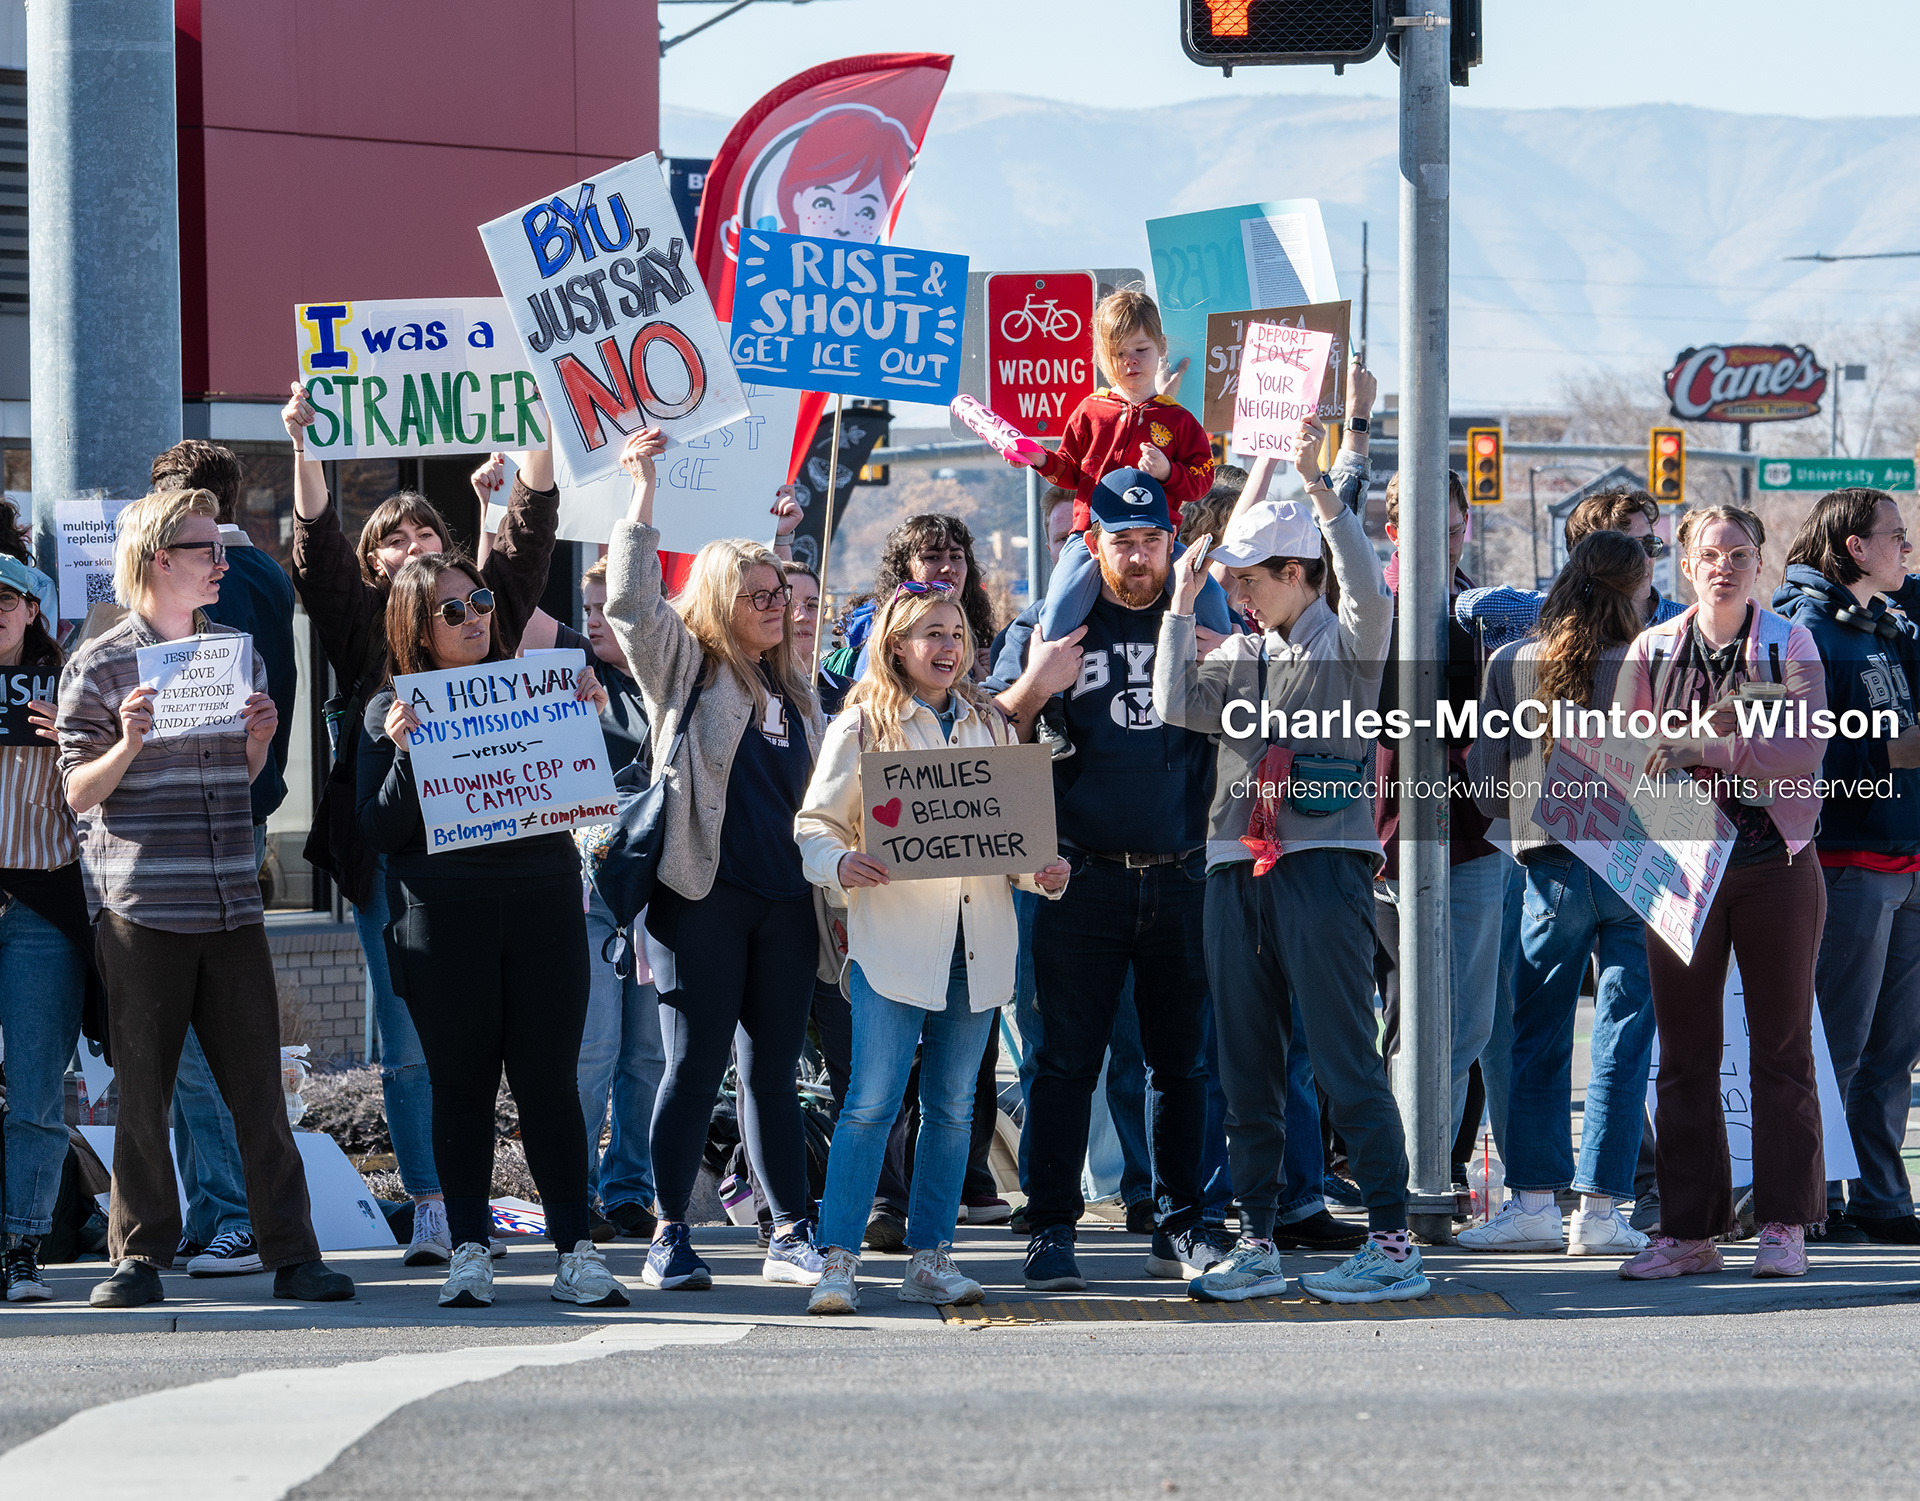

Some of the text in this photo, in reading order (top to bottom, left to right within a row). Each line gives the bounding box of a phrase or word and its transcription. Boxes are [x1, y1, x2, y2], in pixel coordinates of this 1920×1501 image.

[522, 182, 650, 280] BYU,
[789, 241, 947, 297] RISE &
[527, 238, 694, 352] JUST SAY
[750, 288, 934, 344] SHOUT
[304, 305, 494, 369] I was a
[1258, 326, 1311, 346] DEPORT
[732, 334, 949, 379] GET ICE OUT
[998, 358, 1085, 385] WRONG
[552, 320, 707, 453] NO
[1256, 372, 1294, 395] YOUR
[1674, 345, 1824, 418] Cane's
[305, 371, 546, 447] STRANGER
[1018, 392, 1067, 418] WAY
[1797, 467, 1874, 484] University
[1884, 467, 1910, 481] Ave
[63, 521, 117, 532] multiplyi
[73, 560, 92, 568] your
[95, 558, 112, 567] skin
[163, 648, 230, 664] JESUS SAID
[1071, 642, 1155, 700] BY
[181, 666, 215, 680] LOVE
[1860, 652, 1911, 710] BYU
[161, 684, 235, 699] EVERYONE
[411, 667, 577, 713] A HOLY WAR
[161, 701, 230, 713] TREAT THEM
[204, 714, 237, 726] TOO!
[409, 700, 588, 746] BYU'S MISSION STMT
[422, 757, 596, 798] ALLOWING CBP on
[883, 760, 992, 790] FAMILIES
[466, 783, 553, 814] CAMPUS
[911, 797, 1001, 825] BELONG
[433, 818, 517, 847] Belonging
[882, 832, 1027, 863] TOGETHER
